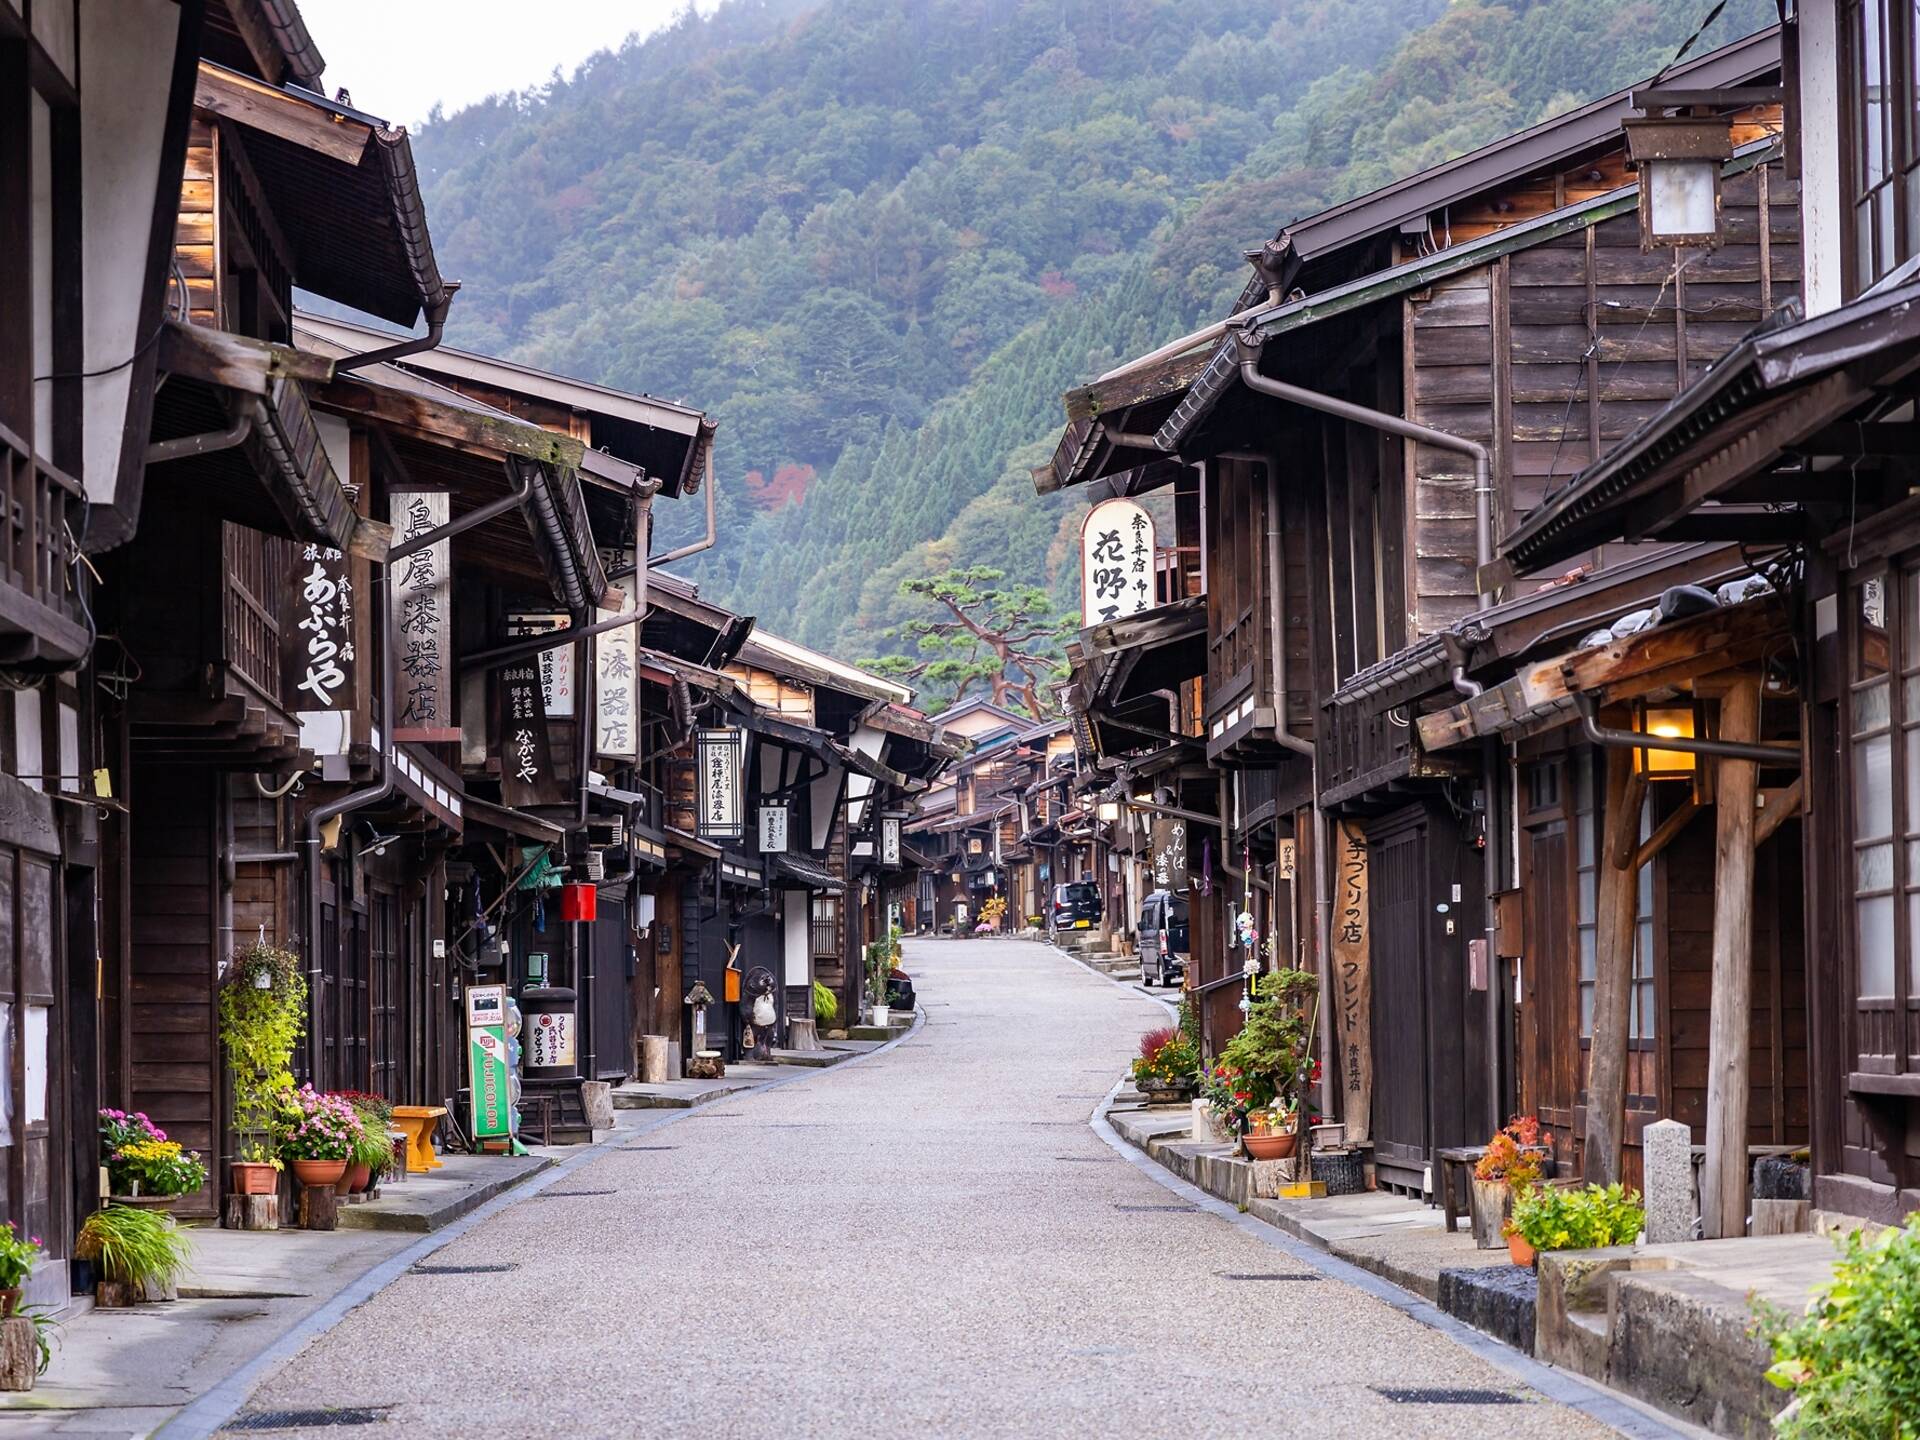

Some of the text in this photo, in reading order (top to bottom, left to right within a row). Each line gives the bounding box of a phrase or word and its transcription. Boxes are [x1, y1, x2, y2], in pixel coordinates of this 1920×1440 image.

[303, 543, 342, 562] 旅館
[297, 562, 345, 706] あぶらや
[337, 574, 354, 662] 奈良井宿
[515, 728, 538, 784] ながとや
[1171, 822, 1185, 870] めんば
[1340, 840, 1368, 943] 手づくりの店
[1342, 962, 1358, 1032] フレンド
[483, 1051, 498, 1129] FUJICOLOR
[1348, 1043, 1360, 1092] 奈良井宿
